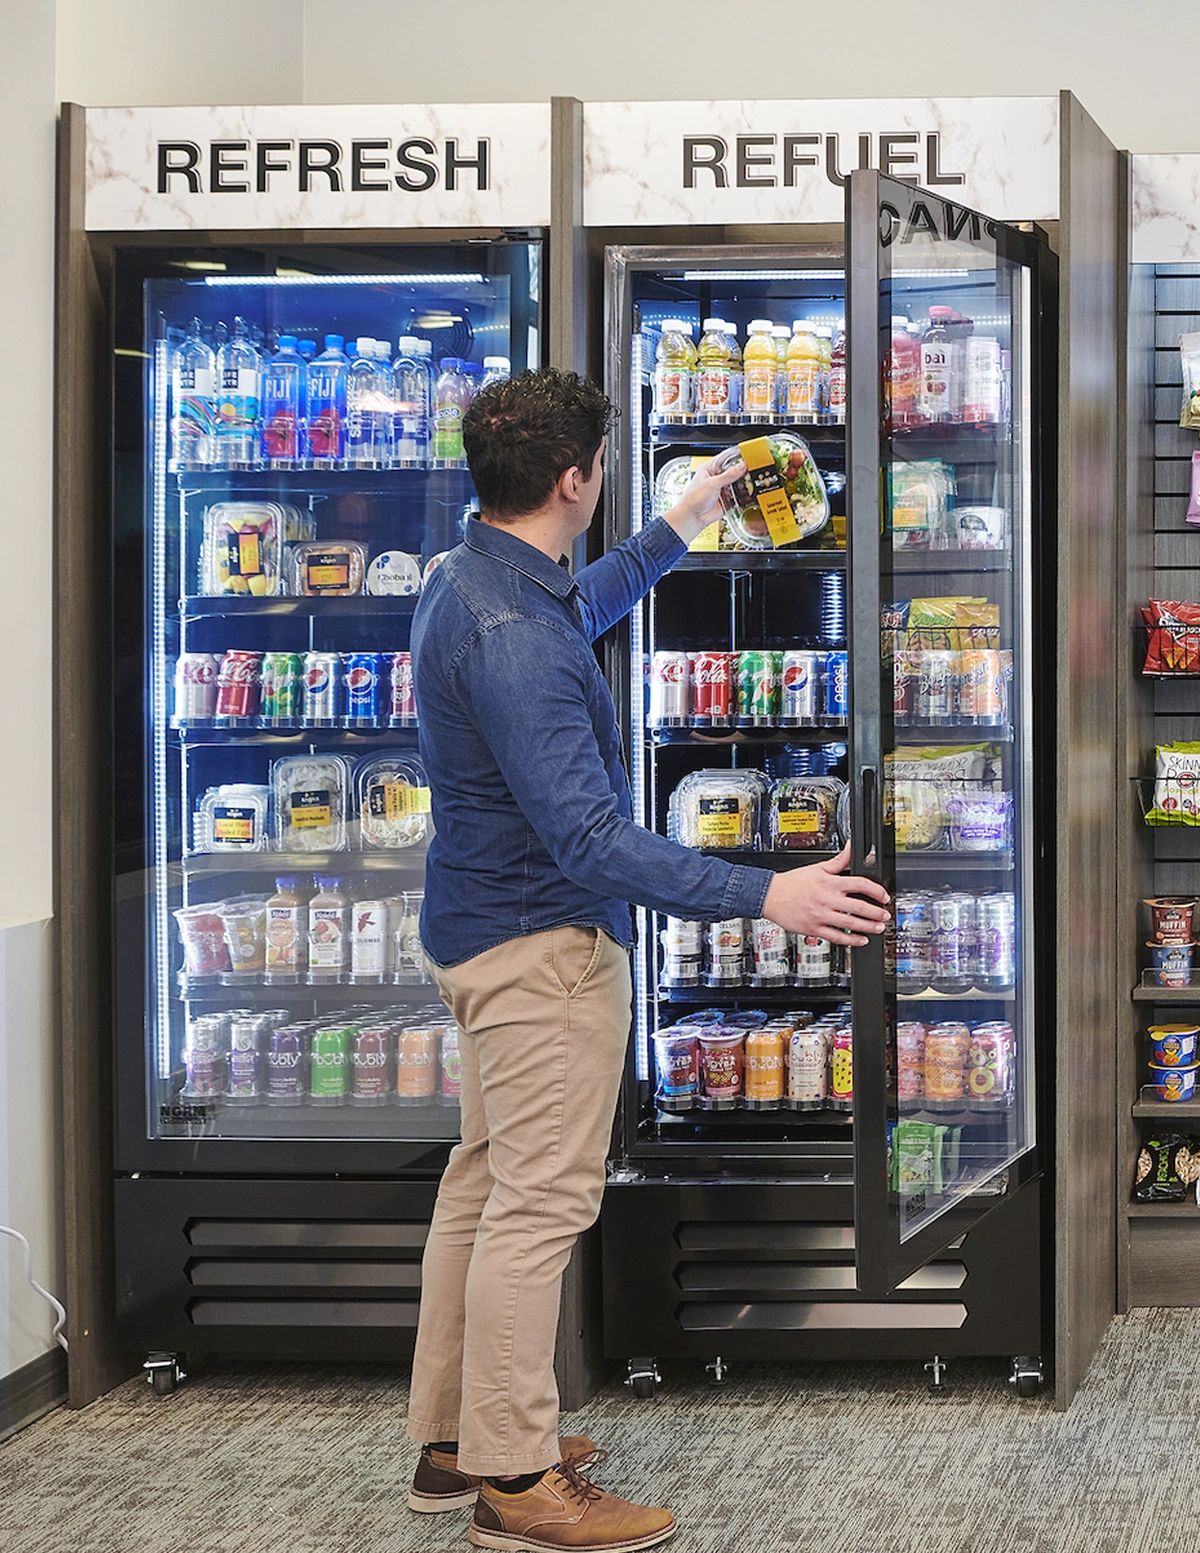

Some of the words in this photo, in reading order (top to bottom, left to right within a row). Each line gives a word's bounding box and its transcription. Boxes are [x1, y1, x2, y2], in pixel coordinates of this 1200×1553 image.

[157, 138, 491, 194] REFRESH
[683, 134, 965, 190] REFUEL
[925, 353, 946, 364] bai
[266, 380, 290, 399] FIJI
[311, 380, 336, 398] FIJI
[833, 664, 844, 704] pepsi
[1159, 921, 1186, 930] MUFFIN
[1162, 961, 1189, 970] MUFFIN
